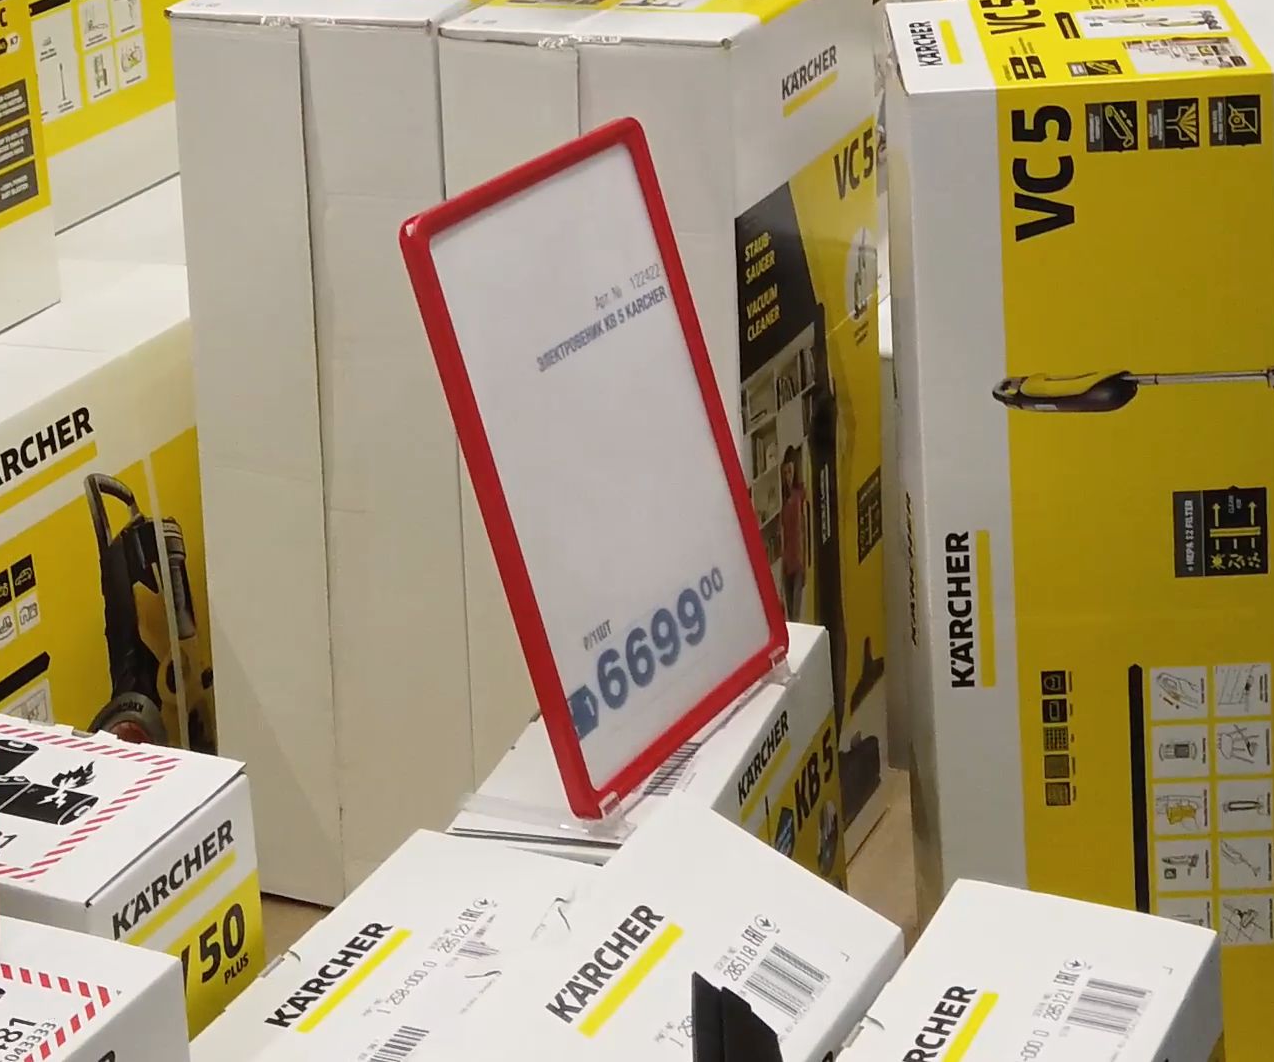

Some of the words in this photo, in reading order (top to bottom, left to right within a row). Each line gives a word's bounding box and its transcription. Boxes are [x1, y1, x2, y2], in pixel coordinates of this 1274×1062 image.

[909, 20, 944, 68] KÄRCHER
[782, 45, 837, 101] KÄRCHER
[744, 232, 772, 263] STAUB-
[745, 251, 776, 285] SAUGER
[626, 284, 668, 321] KARCHER
[747, 283, 779, 318] VACUUM
[747, 308, 781, 343] CLEANER
[945, 530, 975, 690] KÄRCHER
[597, 588, 708, 710] 6699
[737, 710, 790, 806] KÄRCHER
[112, 819, 234, 941] KÄRCHER
[199, 903, 245, 984] 50
[223, 953, 251, 985] PLUS
[545, 904, 665, 1024] KÄRCHER
[723, 945, 758, 982] 285118
[264, 922, 393, 1028] KÄRCHER
[902, 986, 977, 1062] RCHER
